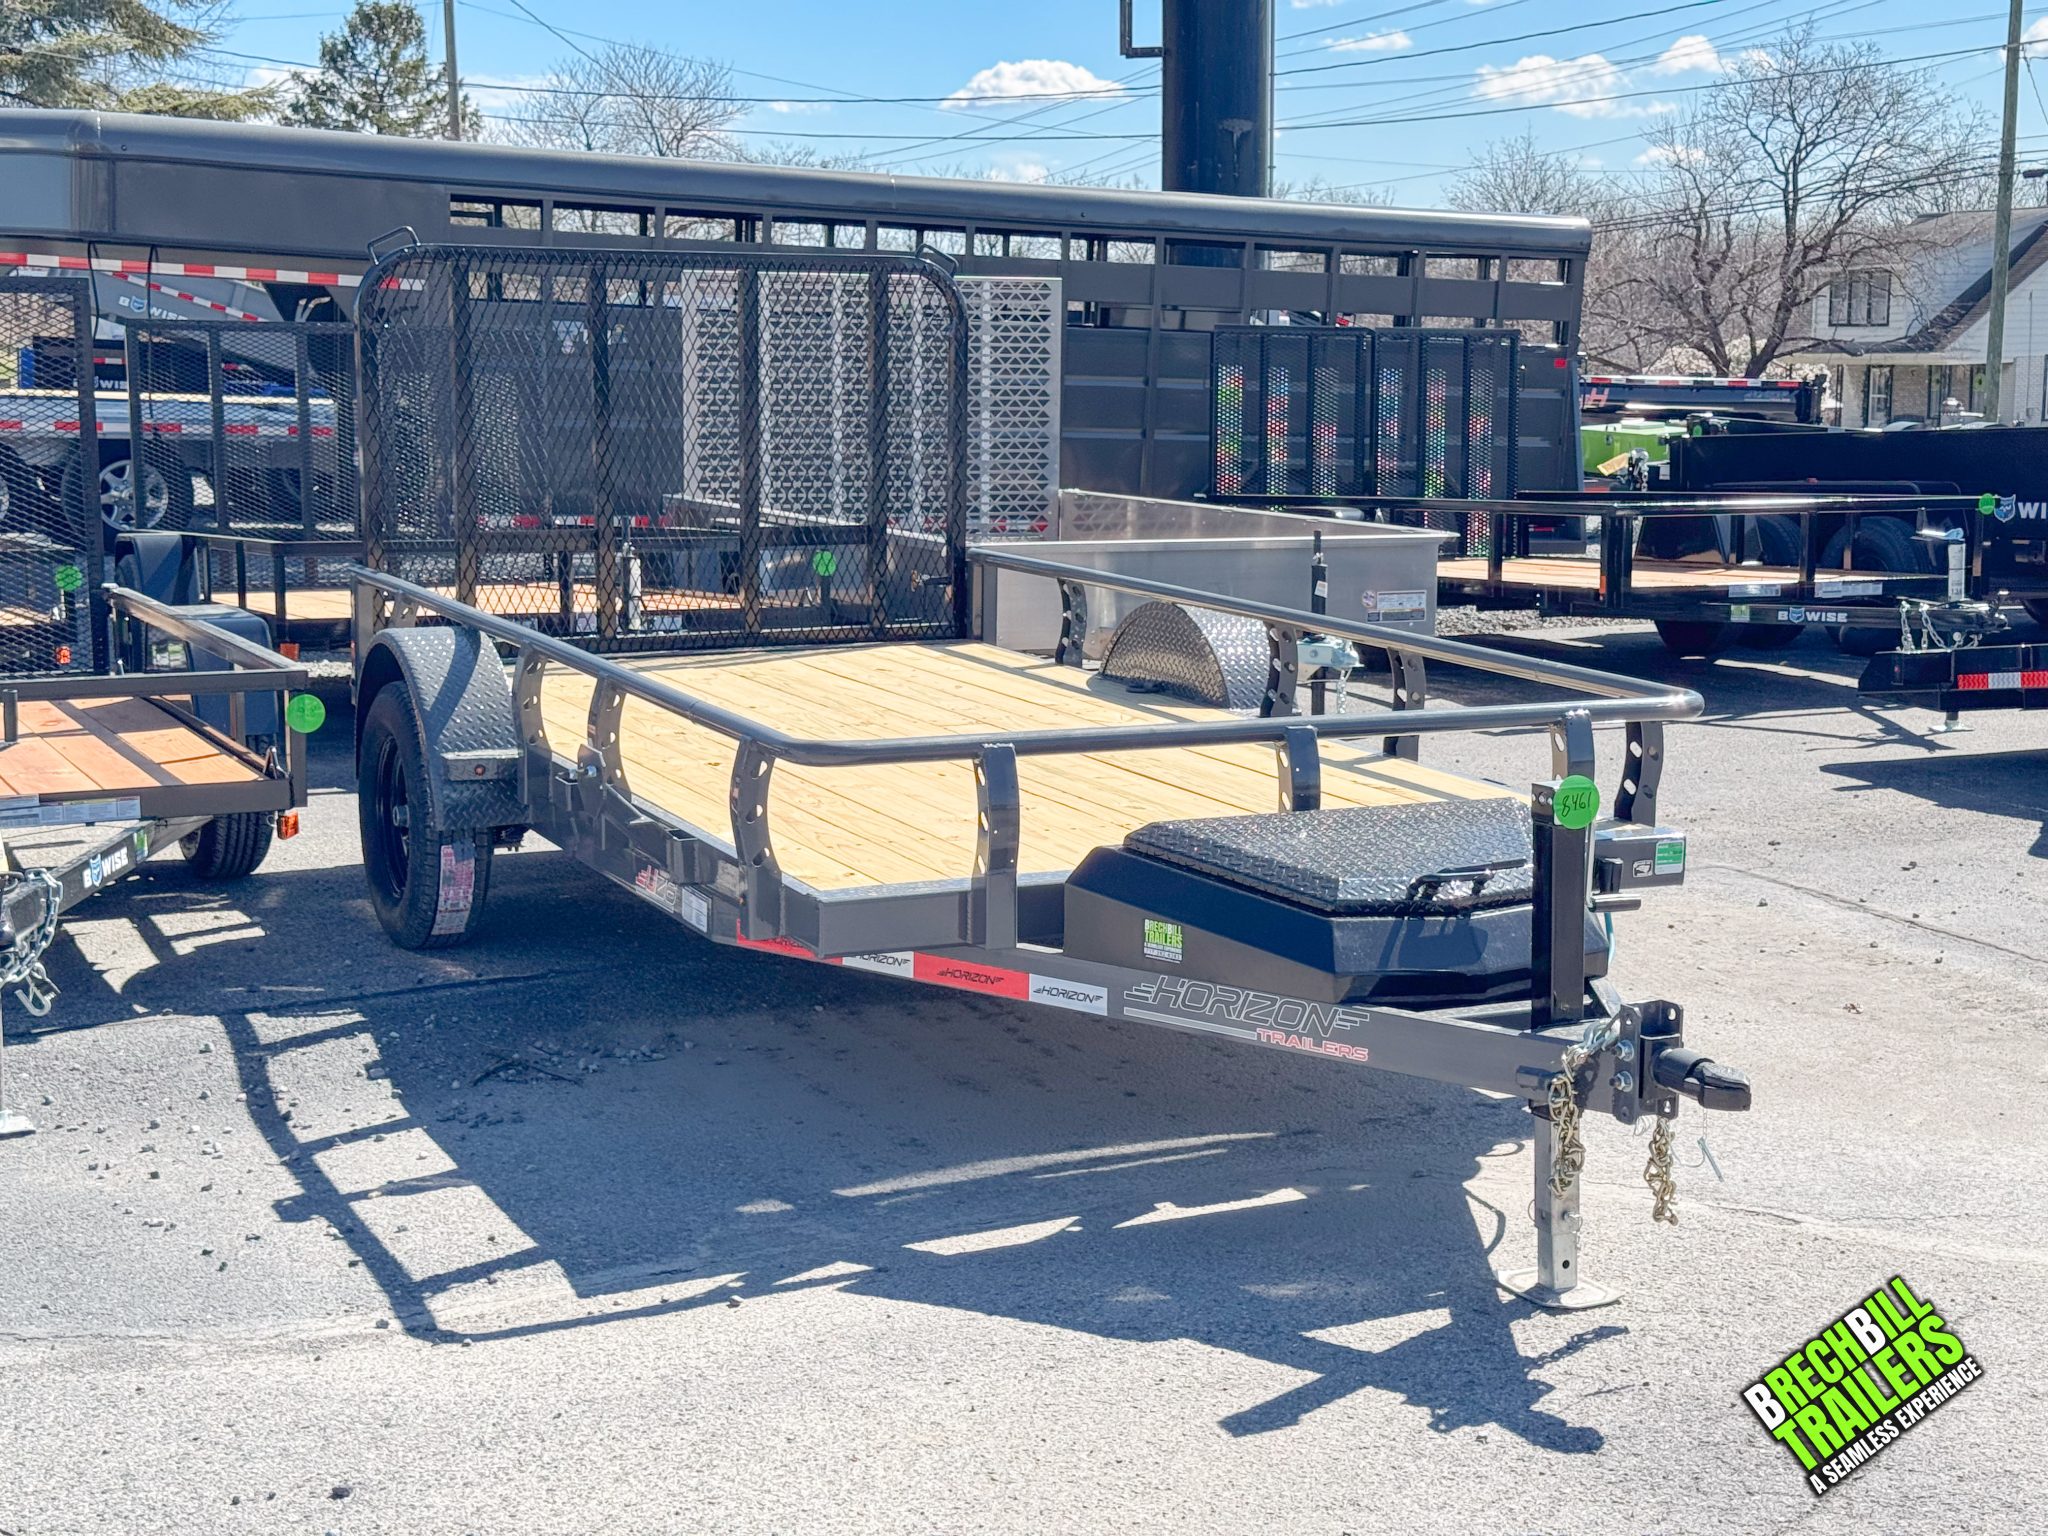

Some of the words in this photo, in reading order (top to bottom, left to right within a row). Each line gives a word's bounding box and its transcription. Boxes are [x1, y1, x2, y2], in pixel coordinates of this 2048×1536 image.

[1562, 792, 1592, 818] 8461
[1144, 918, 1182, 936] BRECHBILL
[1144, 931, 1183, 949] TRAILERS
[942, 967, 997, 985] HORIZON
[1039, 985, 1097, 1004] HORIZON
[1149, 975, 1343, 1037] HORIZON
[1256, 1028, 1369, 1062] TRAILERS
